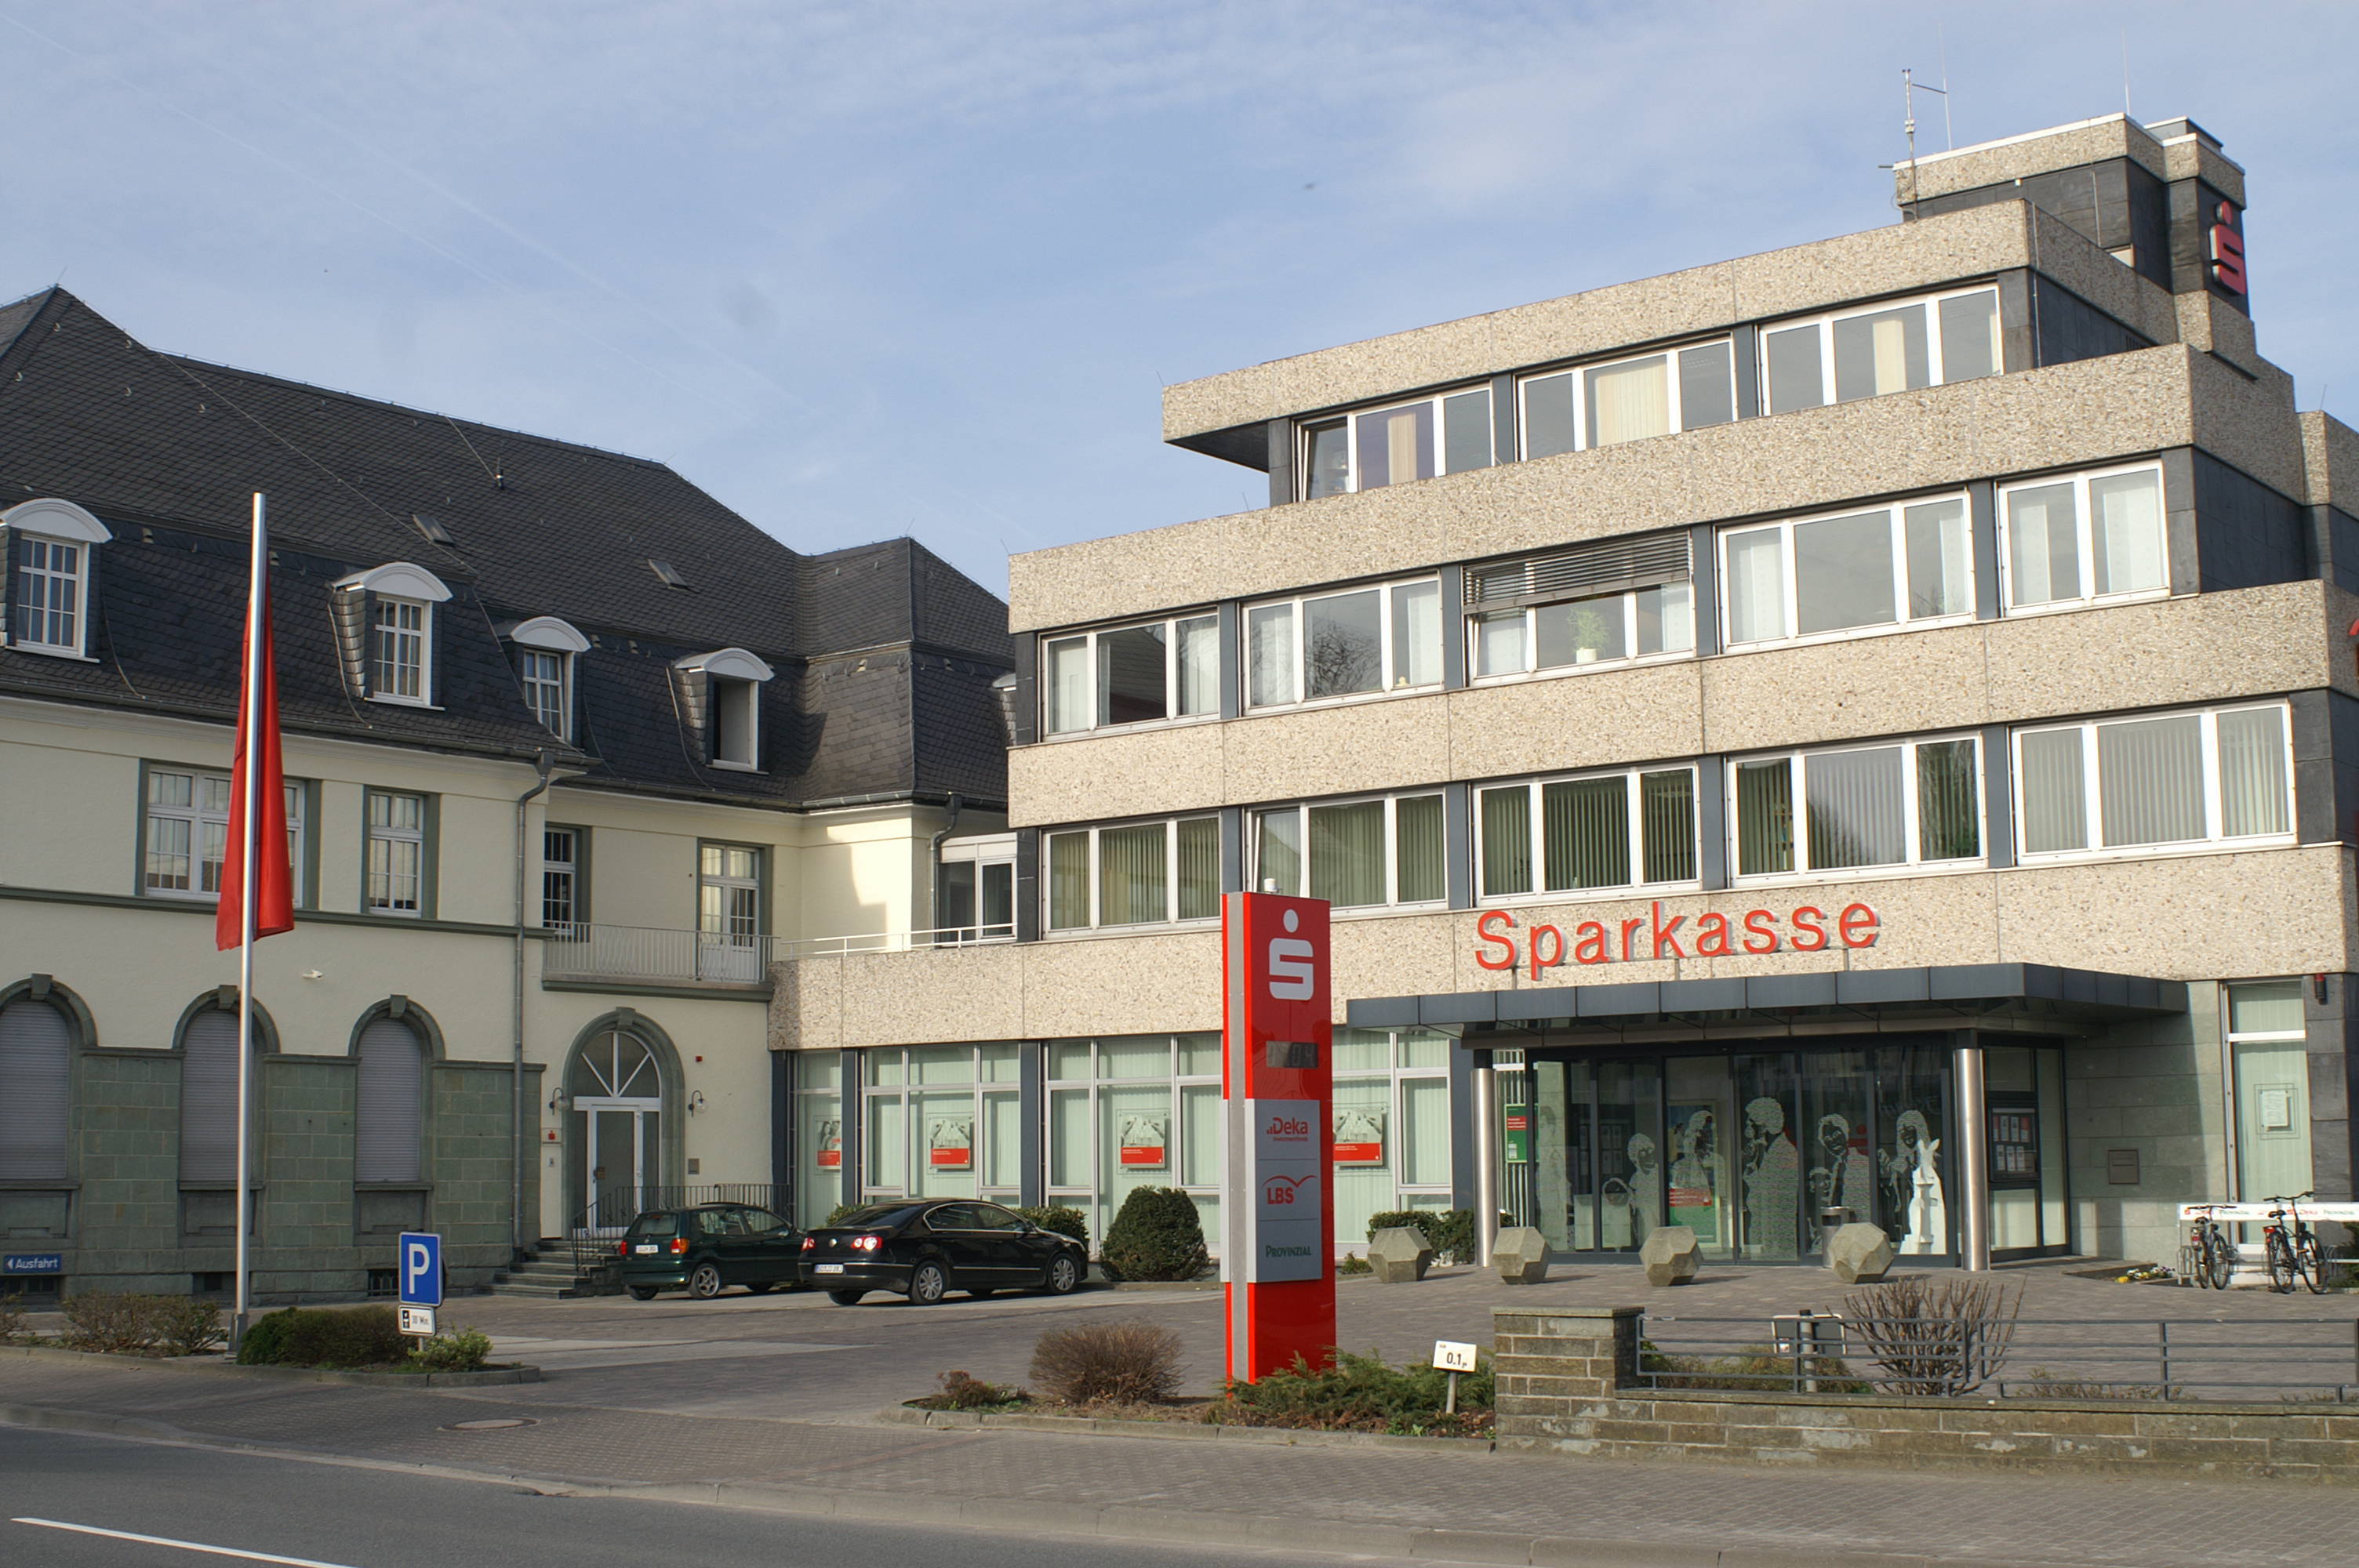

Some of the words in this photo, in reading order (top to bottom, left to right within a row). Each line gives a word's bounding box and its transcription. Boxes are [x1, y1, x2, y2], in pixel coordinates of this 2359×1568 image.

[1475, 901, 1881, 981] Sparkasse
[1267, 1116, 1309, 1135] Deka
[1267, 1187, 1296, 1205] LBS
[15, 1258, 59, 1269] Ausfahrt
[409, 1243, 430, 1294] P
